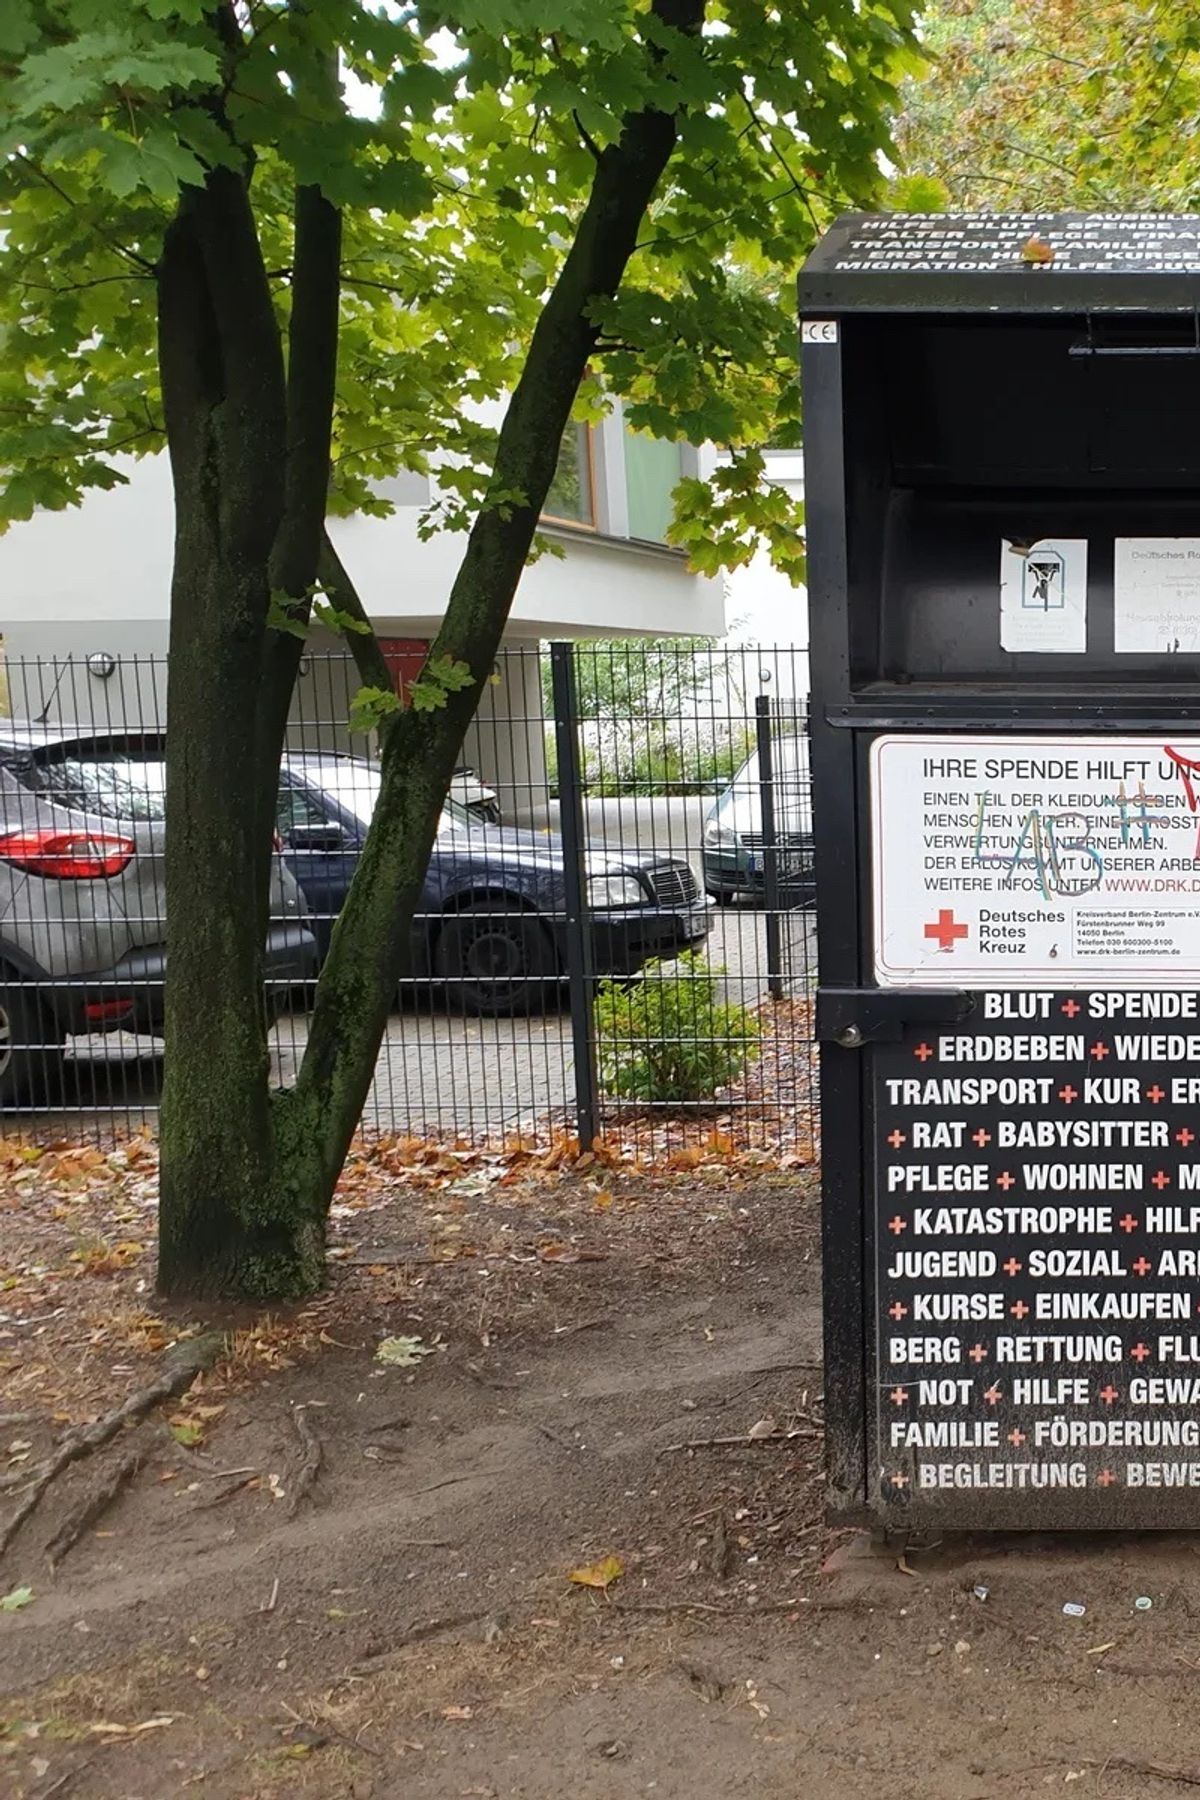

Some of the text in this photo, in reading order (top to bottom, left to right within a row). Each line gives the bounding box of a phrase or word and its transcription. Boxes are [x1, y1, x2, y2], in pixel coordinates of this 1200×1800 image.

[892, 212, 1054, 221] BABYSITTER
[861, 221, 936, 230] HILFE
[967, 221, 1036, 230] BLUT
[1066, 221, 1172, 230] SPENDE
[879, 230, 965, 239] ALTER
[998, 231, 1099, 240] PFLEGE
[850, 240, 1018, 250] TRANSPORT
[1050, 240, 1163, 250] FAMILIE
[868, 250, 959, 260] ERSTE
[1105, 251, 1200, 260] KURSE
[835, 261, 1001, 271] MIGRATION
[1031, 261, 1113, 271] HILFE
[1131, 550, 1185, 560] Deutsches
[923, 758, 977, 780] IHRE
[985, 759, 1080, 780] SPENDE
[1087, 761, 1150, 780] HILFT
[923, 792, 969, 806] EINEN
[974, 793, 1006, 806] TEIL
[1011, 793, 1044, 807] DER
[1049, 793, 1128, 808] KLEIDUNG
[923, 813, 1013, 828] MENSCHEN
[924, 856, 956, 870] DER
[1081, 857, 1155, 872] UNSERER
[924, 877, 993, 891] WEITERE
[997, 878, 1044, 892] INFOS
[1049, 878, 1101, 892] UNTER
[979, 908, 1065, 923] Deutsches
[1076, 910, 1127, 918] Kreisverband
[1128, 910, 1186, 918] Berlin-Zentrum
[1076, 919, 1166, 928] Fürstenbrunner Weg 99
[979, 924, 1027, 939] Rotes
[1077, 929, 1125, 937] 14050 Berlin
[979, 941, 1027, 955] Kreuz
[1076, 947, 1181, 955] www.drk-berlin-zentrum.de
[984, 992, 1054, 1019] BLUT
[1088, 992, 1197, 1019] SPENDE
[939, 1035, 1085, 1062] ERDBEBEN
[885, 1078, 1054, 1105] TRANSPORT
[1084, 1078, 1140, 1105] KUR
[913, 1121, 967, 1148] RAT
[998, 1121, 1169, 1148] BABYSITTER
[887, 1163, 989, 1191] PFLEGE
[1022, 1163, 1144, 1191] WOHNEN
[914, 1207, 1113, 1234] KATASTROPHE
[887, 1250, 997, 1278] JUGEND
[1028, 1250, 1127, 1278] SOZIAL
[913, 1293, 1005, 1320] KURSE
[1036, 1293, 1191, 1320] EINKAUFEN
[889, 1336, 961, 1363] BERG
[996, 1336, 1122, 1363] RETTUNG
[918, 1379, 973, 1406] NOT
[1013, 1379, 1090, 1406] HILFE
[890, 1421, 1000, 1448] FAMILIE
[1034, 1416, 1200, 1448] FÖRDERUNG
[920, 1464, 1088, 1490] BEGLEITUNG
